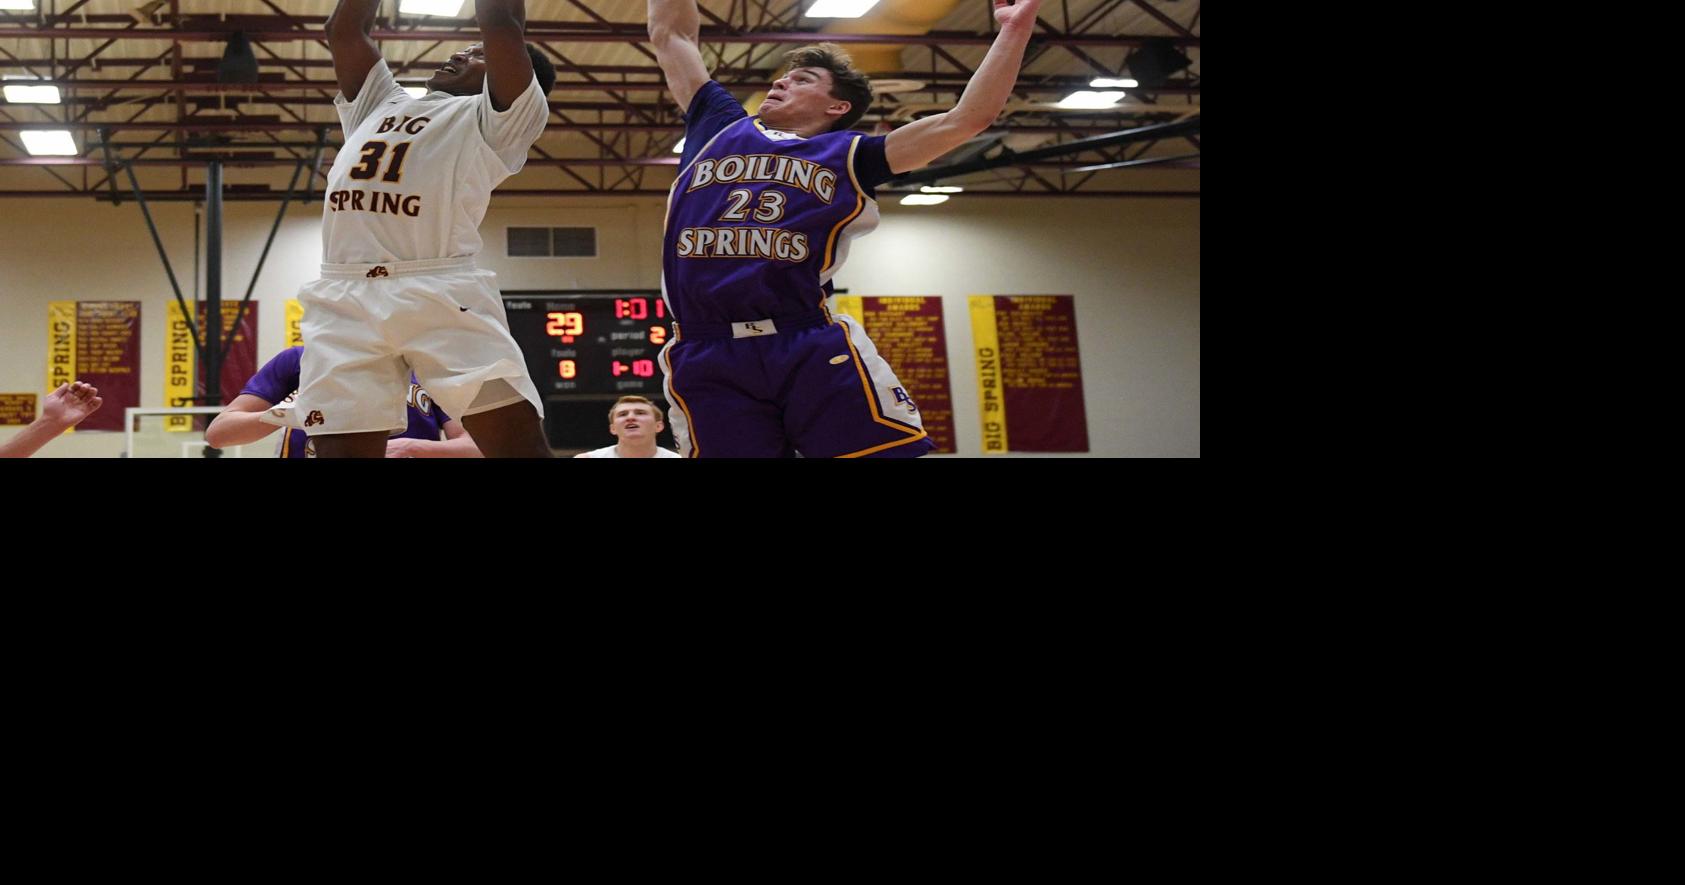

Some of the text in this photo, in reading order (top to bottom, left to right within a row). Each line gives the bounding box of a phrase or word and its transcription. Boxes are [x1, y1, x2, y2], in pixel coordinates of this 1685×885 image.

[376, 115, 431, 135] BIG
[349, 140, 411, 183] 31
[686, 154, 837, 204] BOILING
[329, 189, 421, 217] SPRING
[719, 189, 786, 223] 23
[677, 227, 810, 262] SPRINGS
[546, 312, 583, 336] 29
[611, 330, 646, 341] period
[649, 326, 666, 344] 2
[170, 320, 188, 426] BG SPRING
[979, 347, 1002, 450] BIG SPRING
